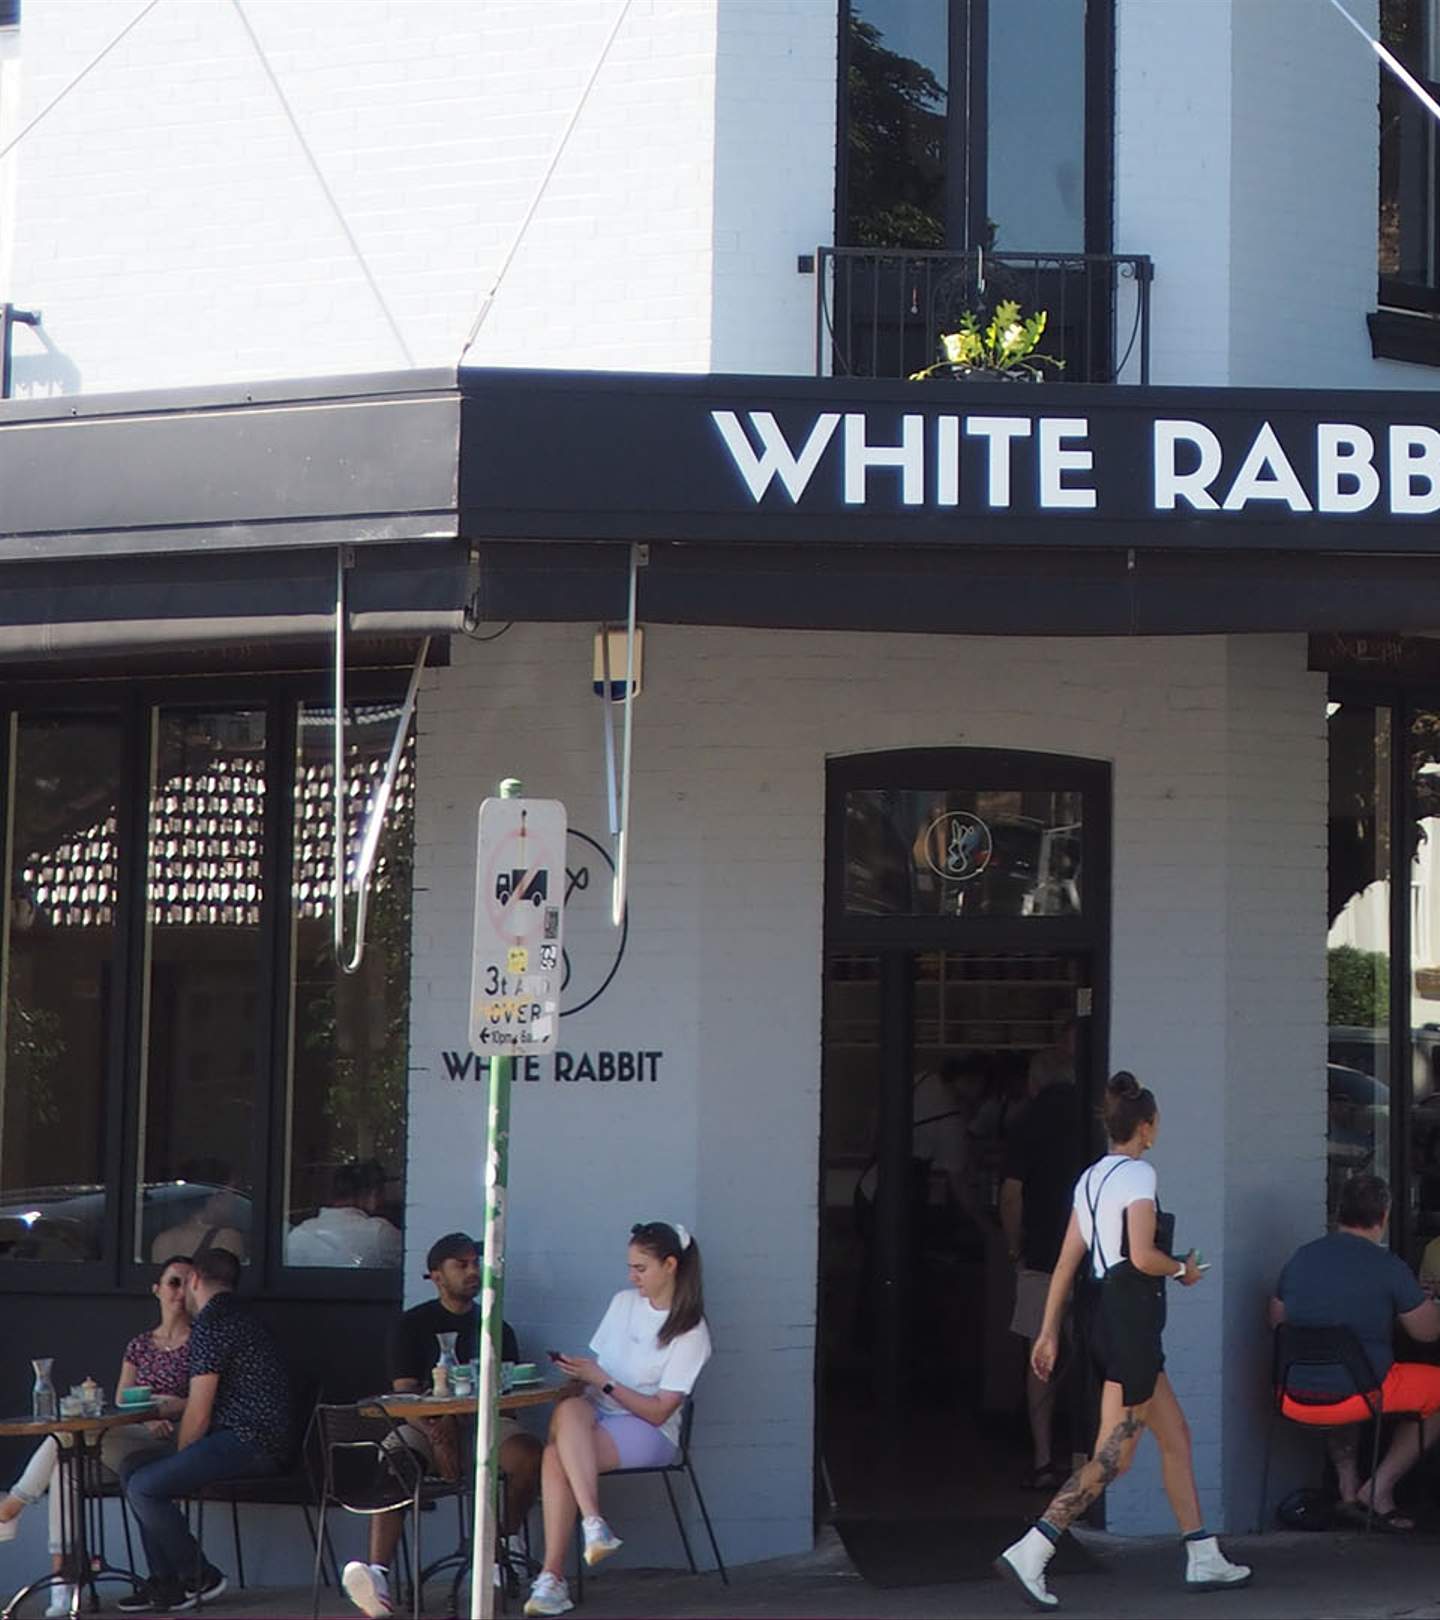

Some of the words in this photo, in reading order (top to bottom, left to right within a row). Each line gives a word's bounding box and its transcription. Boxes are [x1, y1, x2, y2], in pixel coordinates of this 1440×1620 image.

[711, 411, 1096, 508] WHITE
[441, 1051, 540, 1082] WHTE
[554, 1051, 663, 1082] RABBIT
